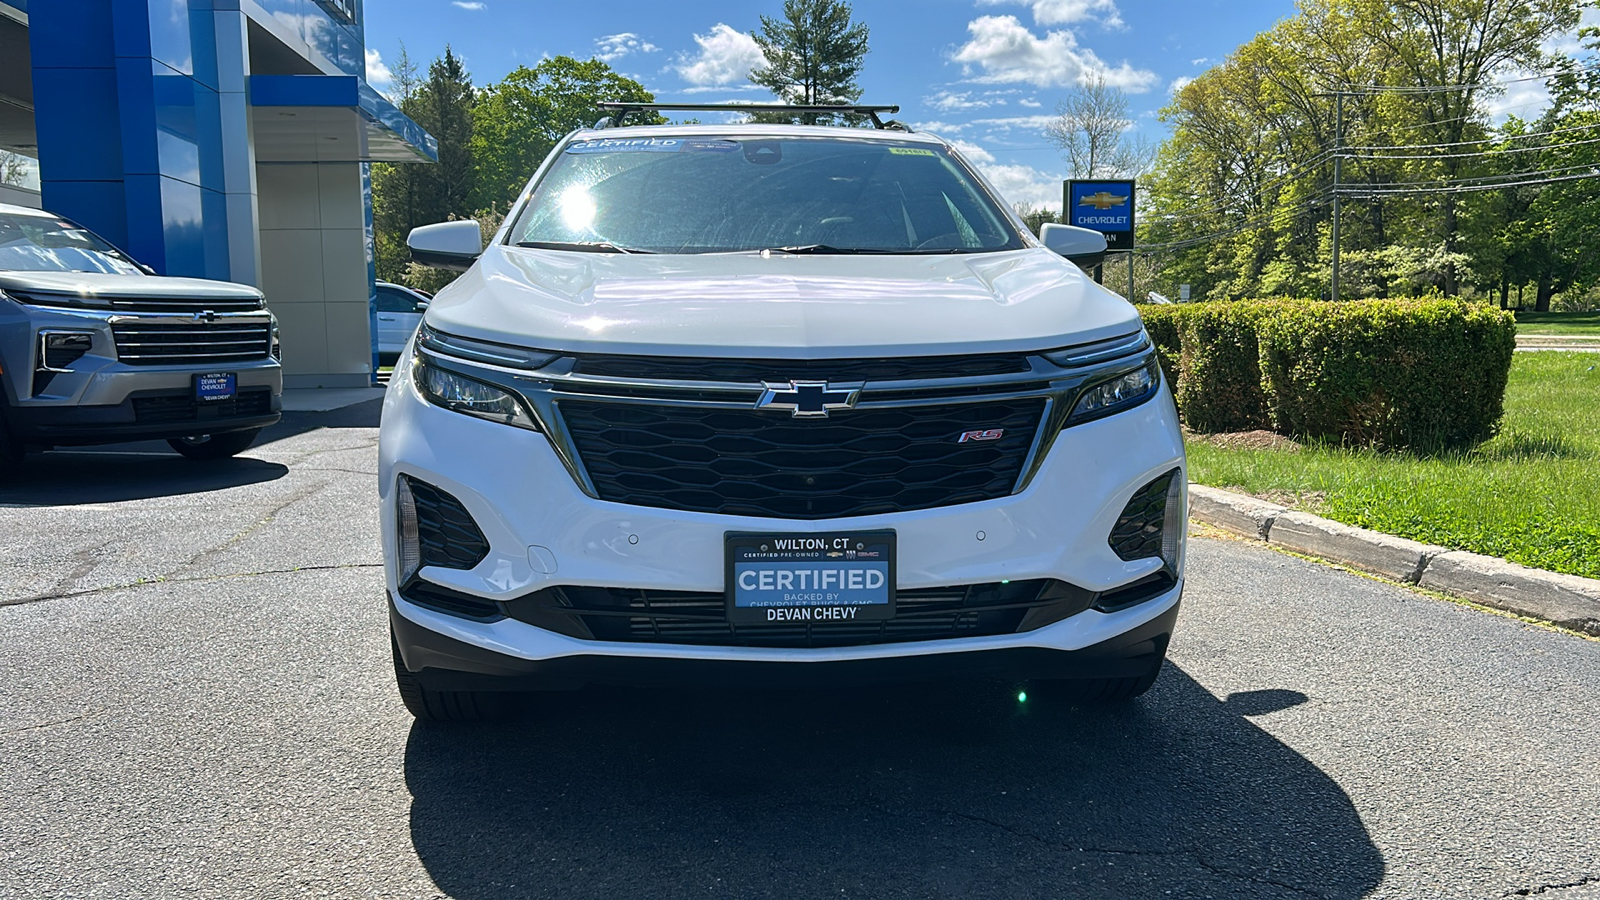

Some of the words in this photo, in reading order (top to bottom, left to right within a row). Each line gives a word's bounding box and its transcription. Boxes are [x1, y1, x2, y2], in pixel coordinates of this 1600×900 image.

[1078, 216, 1127, 224] CHEVROLET
[958, 429, 1004, 443] RS
[774, 538, 829, 550] WILTON,
[833, 538, 850, 549] CT
[738, 569, 885, 591] CERTIFIED
[784, 593, 823, 601] BACKED
[767, 608, 811, 620] DEVAN
[813, 607, 857, 619] CHEVY
